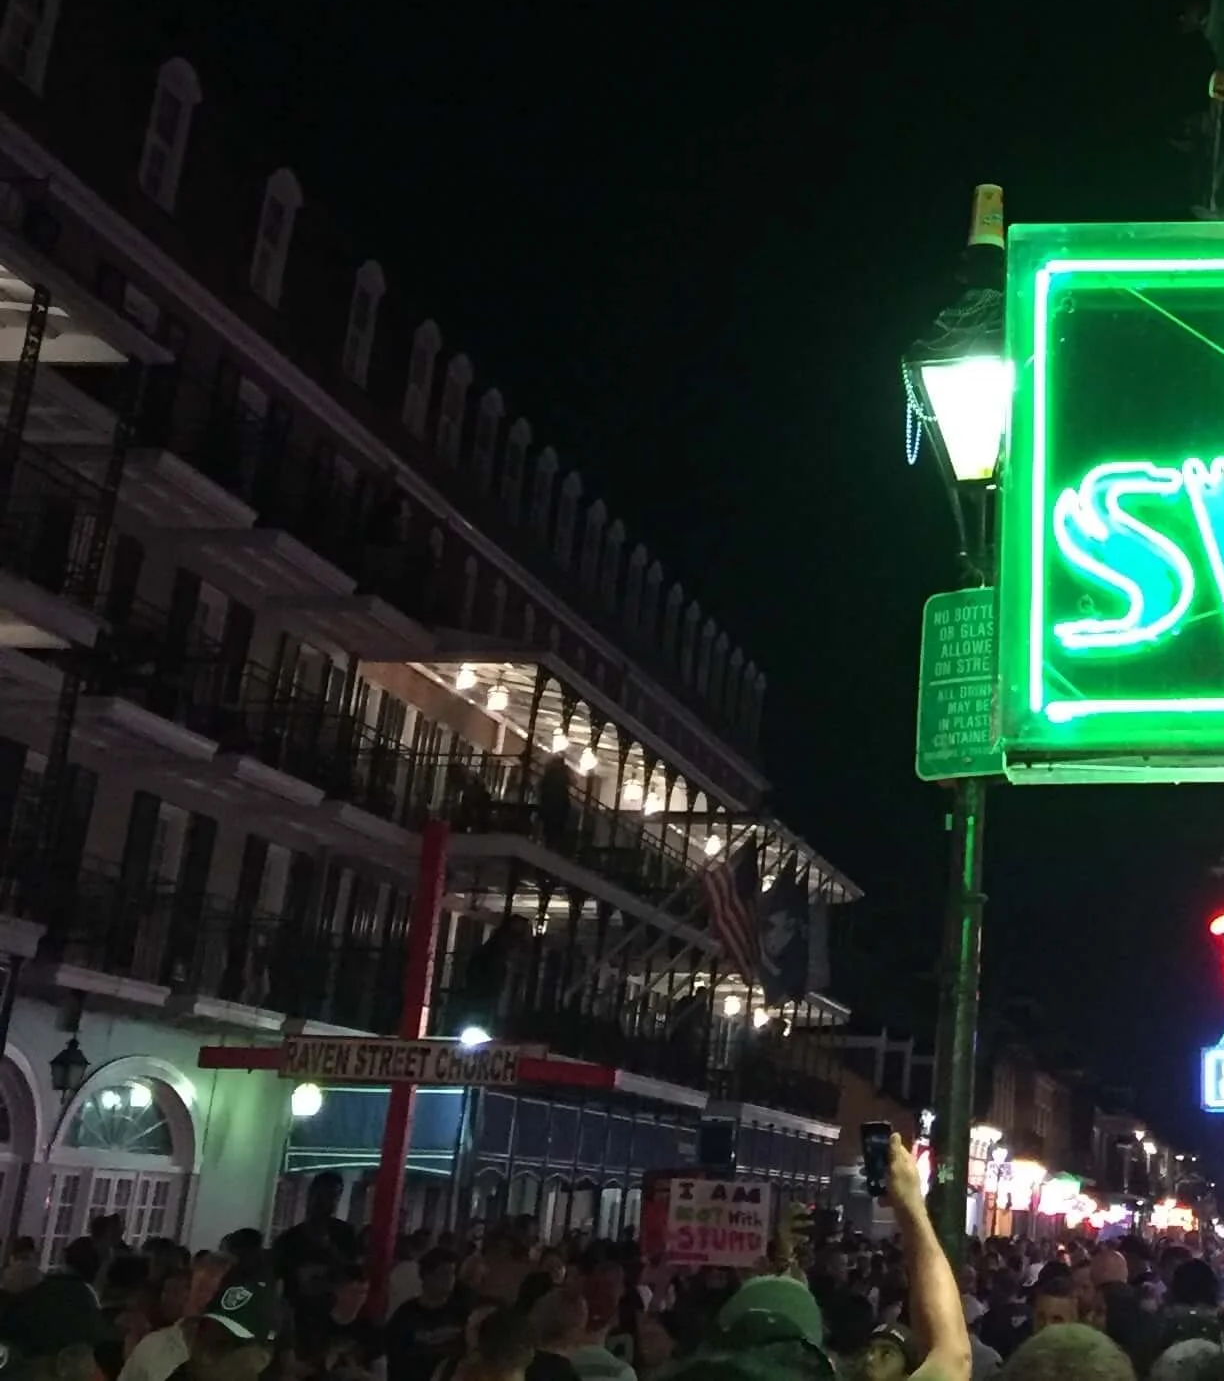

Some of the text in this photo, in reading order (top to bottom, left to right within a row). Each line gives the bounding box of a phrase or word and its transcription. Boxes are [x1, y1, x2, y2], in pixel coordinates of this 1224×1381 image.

[934, 609, 950, 624] NO
[940, 621, 994, 642] OR GLAS
[941, 638, 993, 658] ALLOWE
[934, 656, 990, 677] ON STRE
[938, 688, 954, 702] ALL
[947, 698, 990, 715] MAY BE
[938, 717, 950, 731] IN
[286, 1037, 519, 1083] RAVEN STREET CHURCH
[678, 1182, 761, 1204] I AM
[675, 1204, 763, 1227] NOT With
